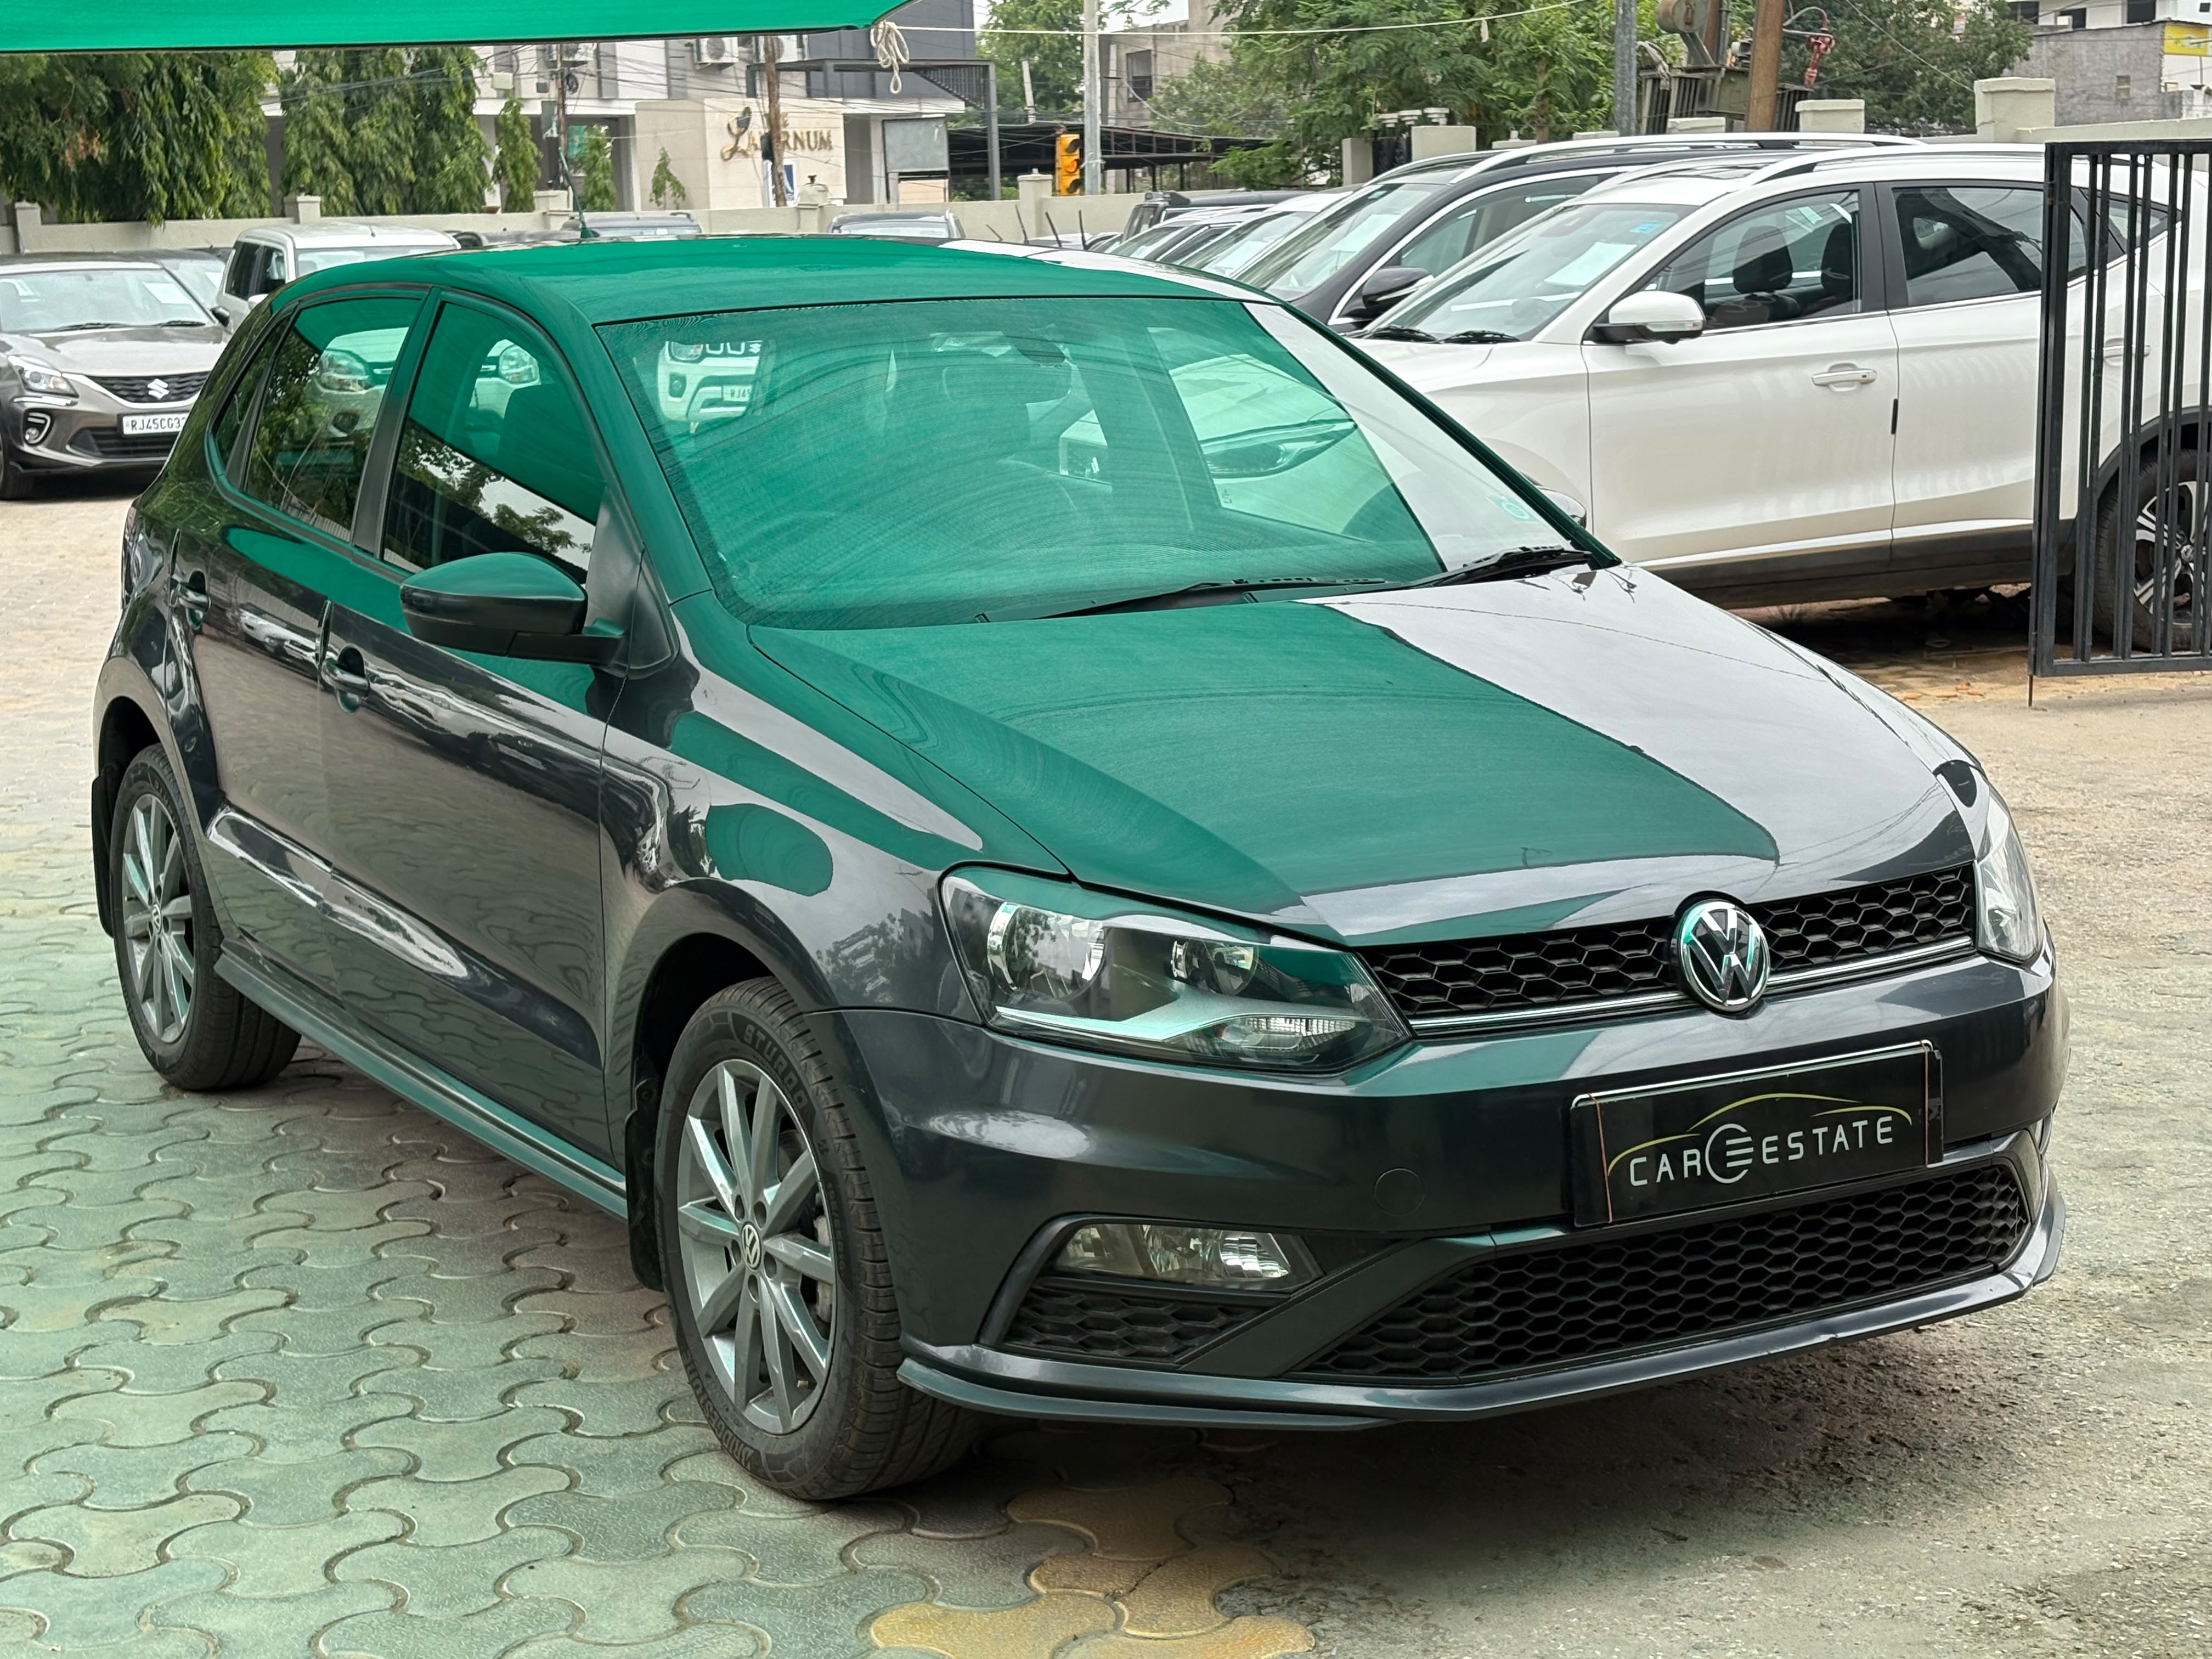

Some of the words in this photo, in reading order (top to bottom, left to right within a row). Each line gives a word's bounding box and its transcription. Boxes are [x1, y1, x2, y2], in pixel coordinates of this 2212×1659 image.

[720, 107, 833, 161] LARNUM
[1629, 1148, 1701, 1187] CAR
[1762, 1115, 1893, 1164] ESTATE
